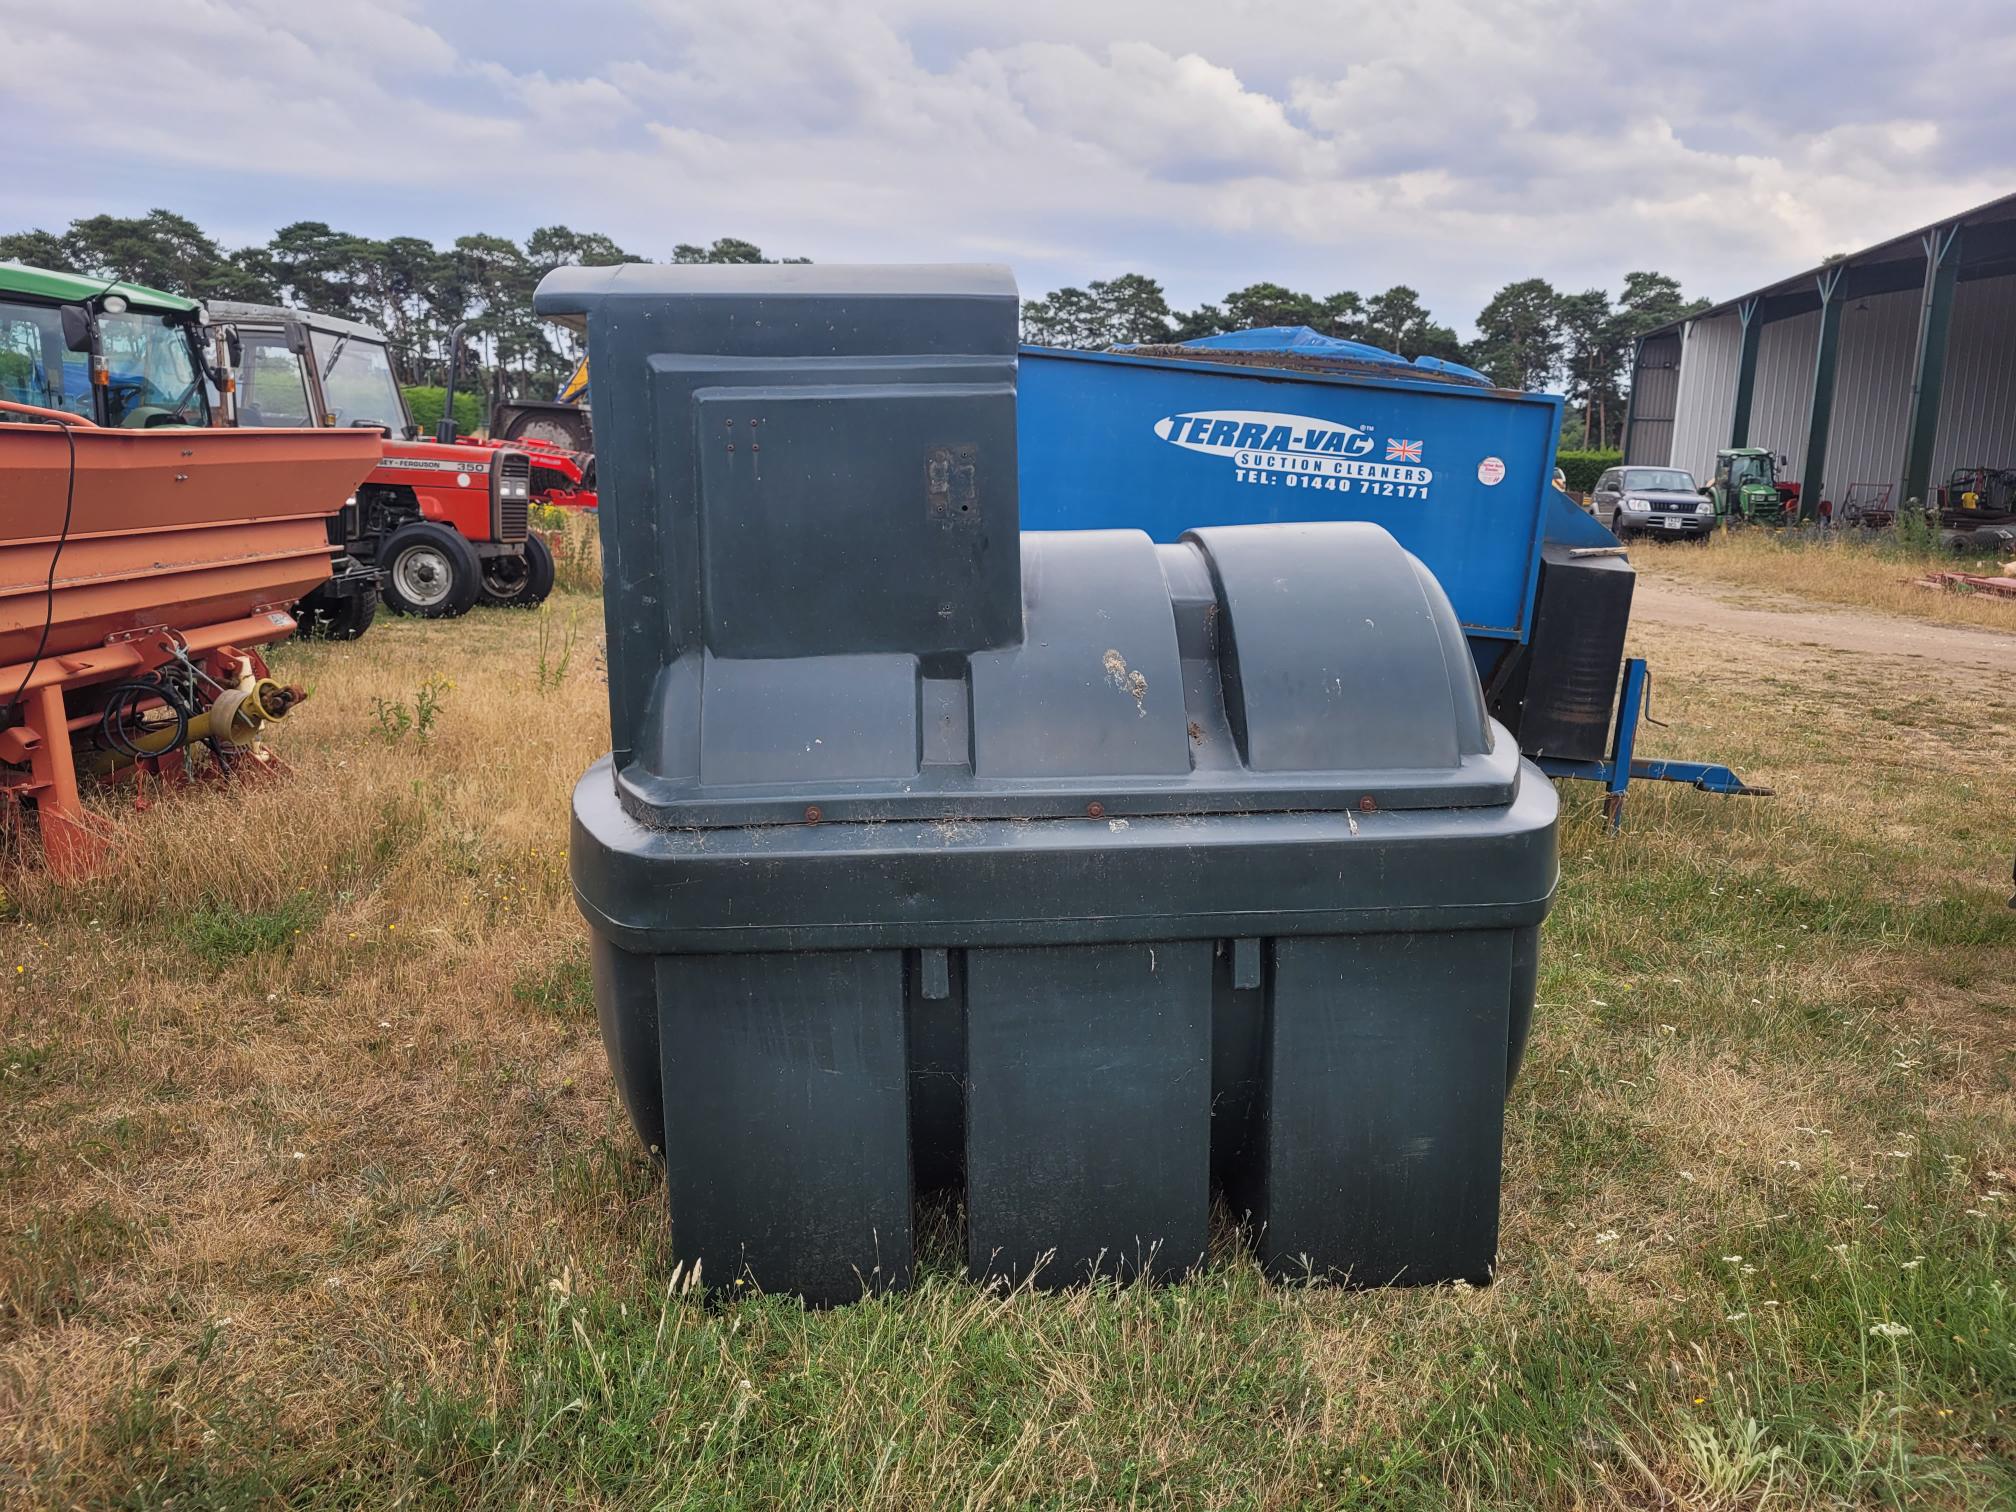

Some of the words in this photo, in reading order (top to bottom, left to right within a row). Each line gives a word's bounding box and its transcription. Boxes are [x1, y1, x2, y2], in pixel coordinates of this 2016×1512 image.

[1166, 415, 1371, 455] TERRA-VAC
[457, 462, 484, 472] 350
[1241, 453, 1322, 472] SUCTION
[1334, 462, 1427, 482] CLEANERS
[1236, 470, 1276, 487] TEL:
[1286, 474, 1350, 492] 01440
[1360, 481, 1428, 499] 712171
